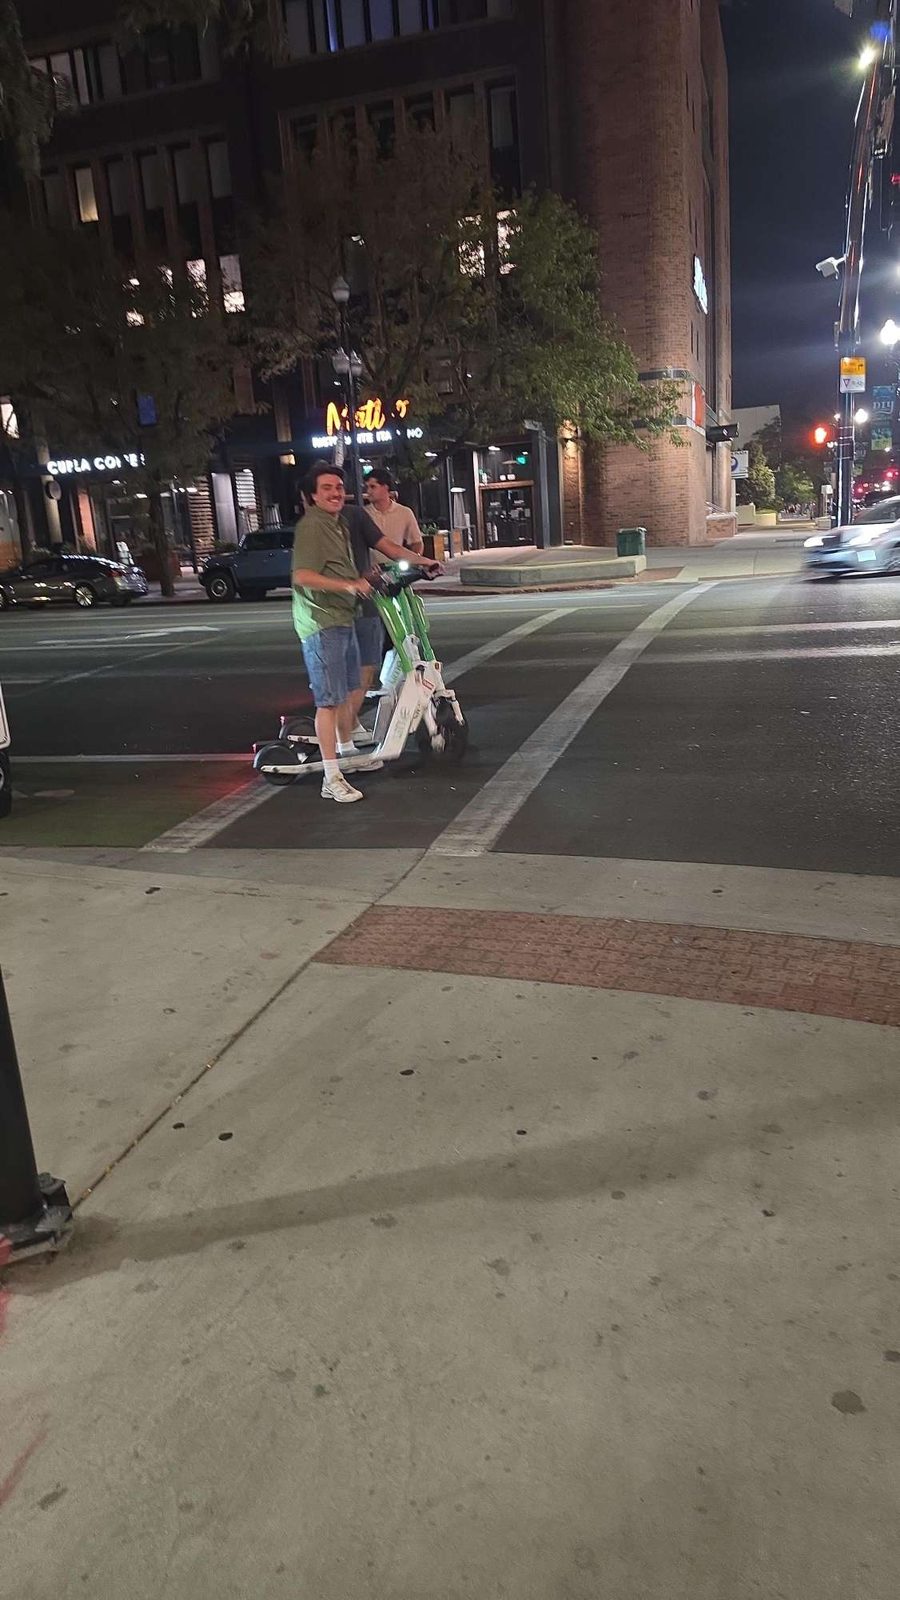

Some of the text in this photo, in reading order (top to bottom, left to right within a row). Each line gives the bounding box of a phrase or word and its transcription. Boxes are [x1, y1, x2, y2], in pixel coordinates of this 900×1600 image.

[326, 398, 410, 436] Matto
[376, 427, 424, 442] ITANO
[93, 453, 146, 471] COE
